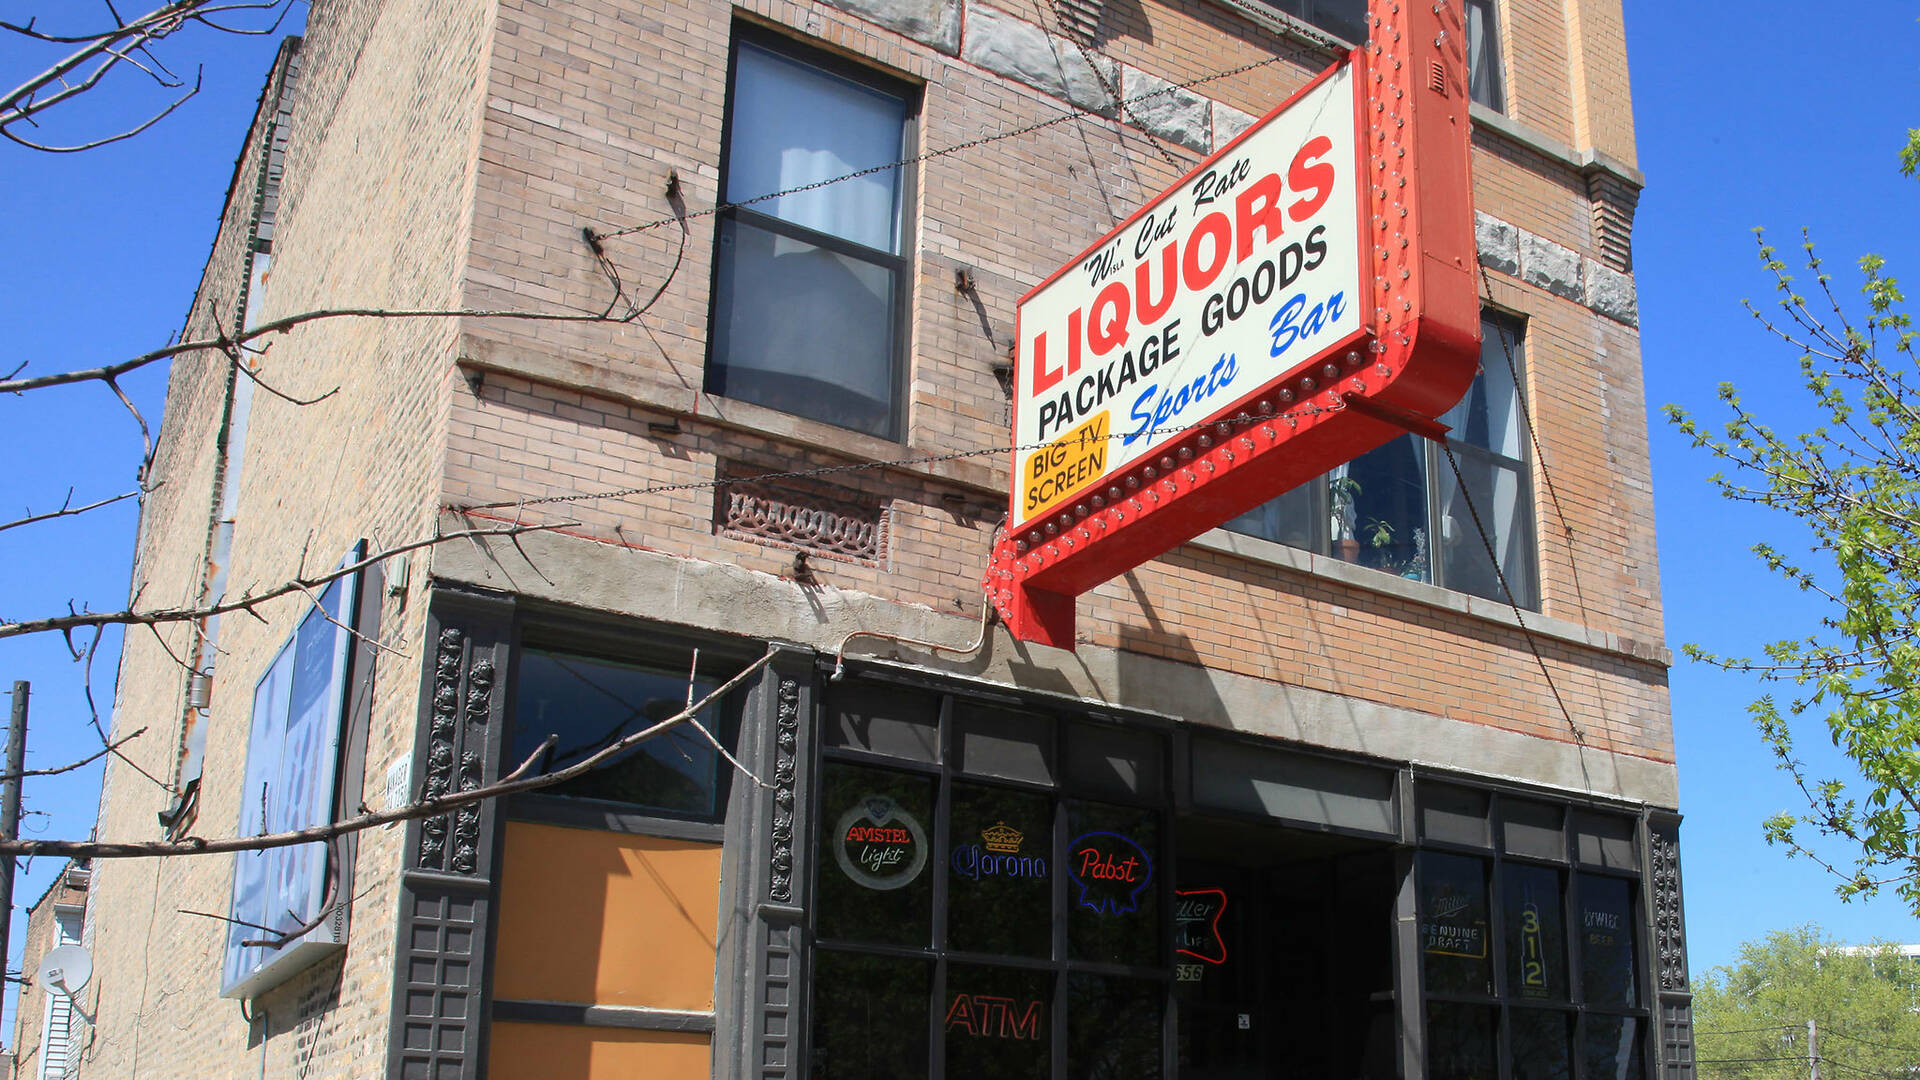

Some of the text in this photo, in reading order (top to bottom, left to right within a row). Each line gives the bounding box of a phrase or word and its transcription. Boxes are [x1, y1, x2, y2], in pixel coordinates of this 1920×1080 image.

[1134, 205, 1178, 260] Cut
[1192, 157, 1252, 217] Rate
[1032, 135, 1336, 398] LIQUORS
[1038, 224, 1328, 442] PACKAGE GOODS
[1123, 290, 1348, 448] Sports Bar
[1027, 447, 1104, 512] SCREEN
[1033, 417, 1104, 480] BIG TV
[846, 826, 911, 843] AMSTEL
[952, 844, 1047, 881] Corona
[1078, 848, 1140, 882] Pabst
[1429, 936, 1471, 951] DRAFT
[1522, 910, 1543, 985] 312
[944, 992, 1046, 1041] ATM
